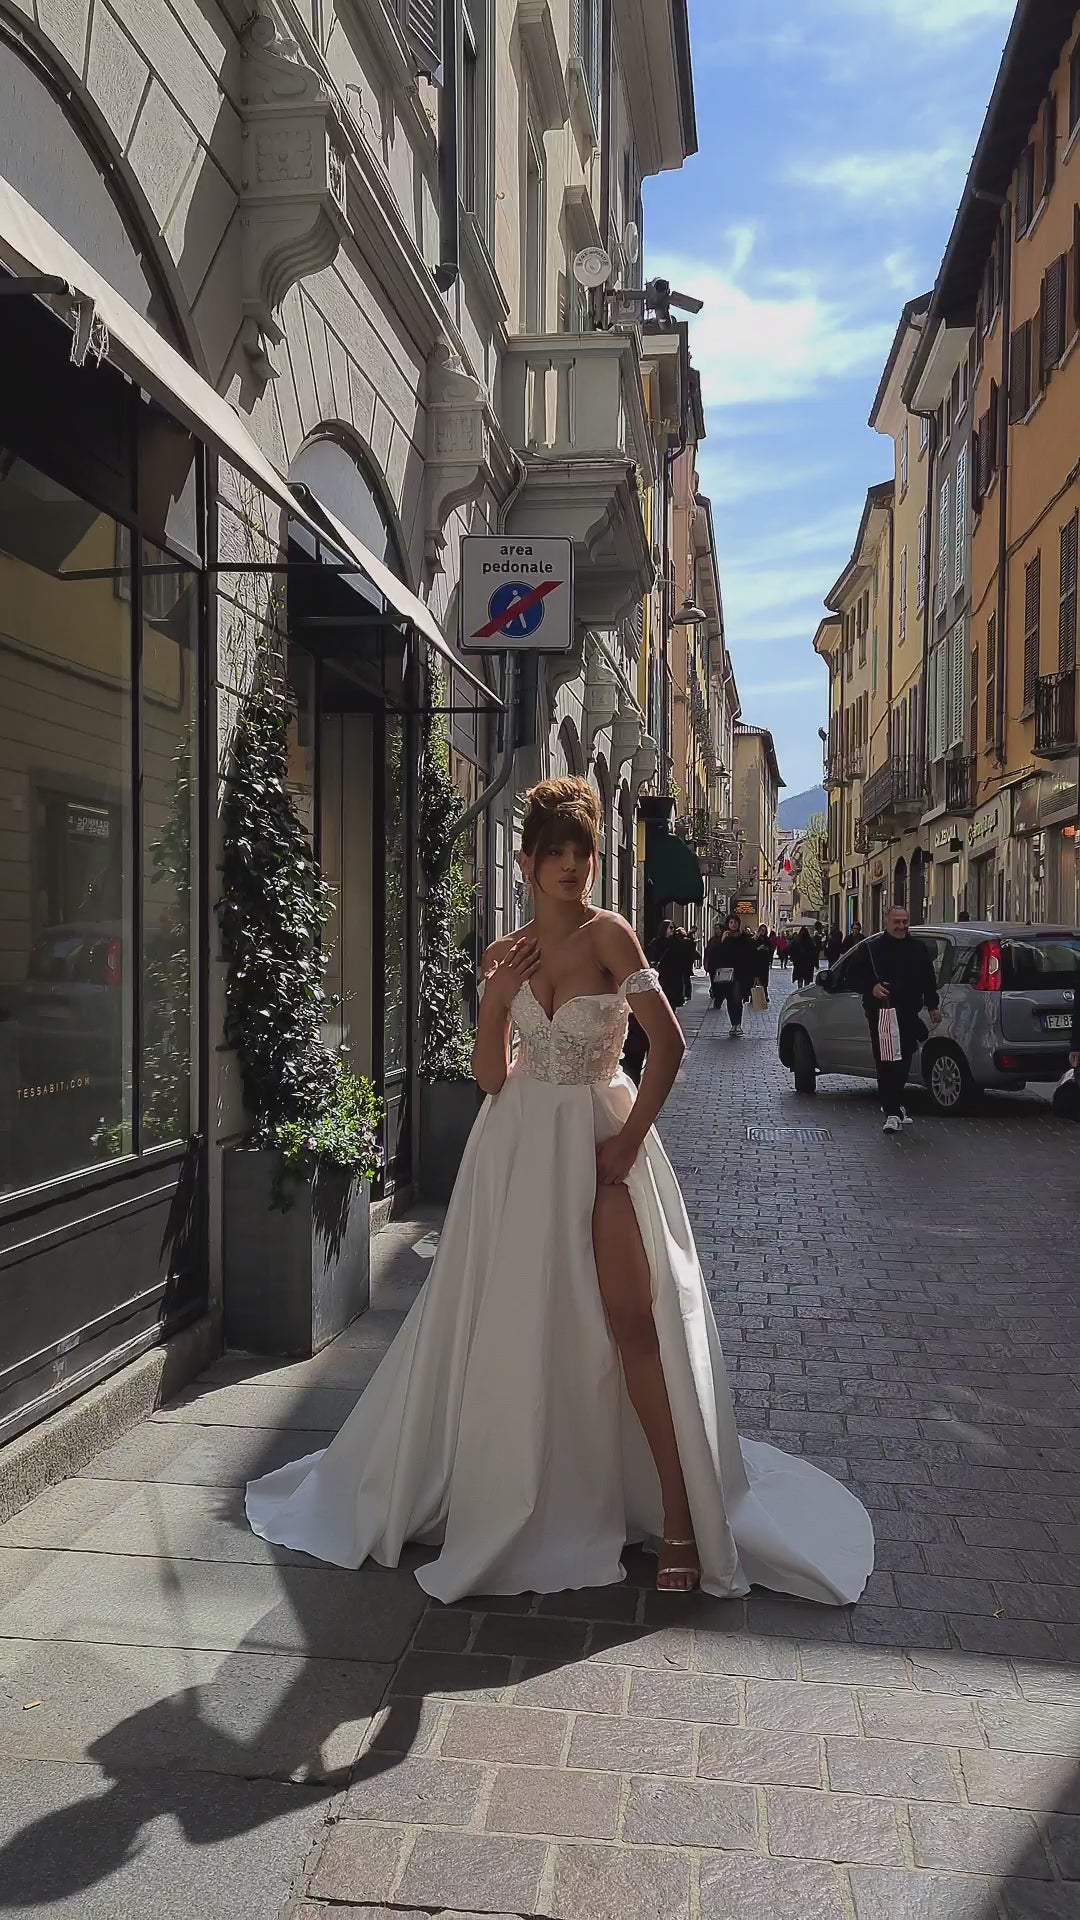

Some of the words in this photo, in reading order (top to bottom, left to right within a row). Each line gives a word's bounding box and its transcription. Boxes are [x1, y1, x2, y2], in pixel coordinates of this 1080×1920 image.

[500, 544, 533, 556] area
[482, 560, 554, 574] pedonale
[17, 1077, 90, 1100] TESSABIT.COM
